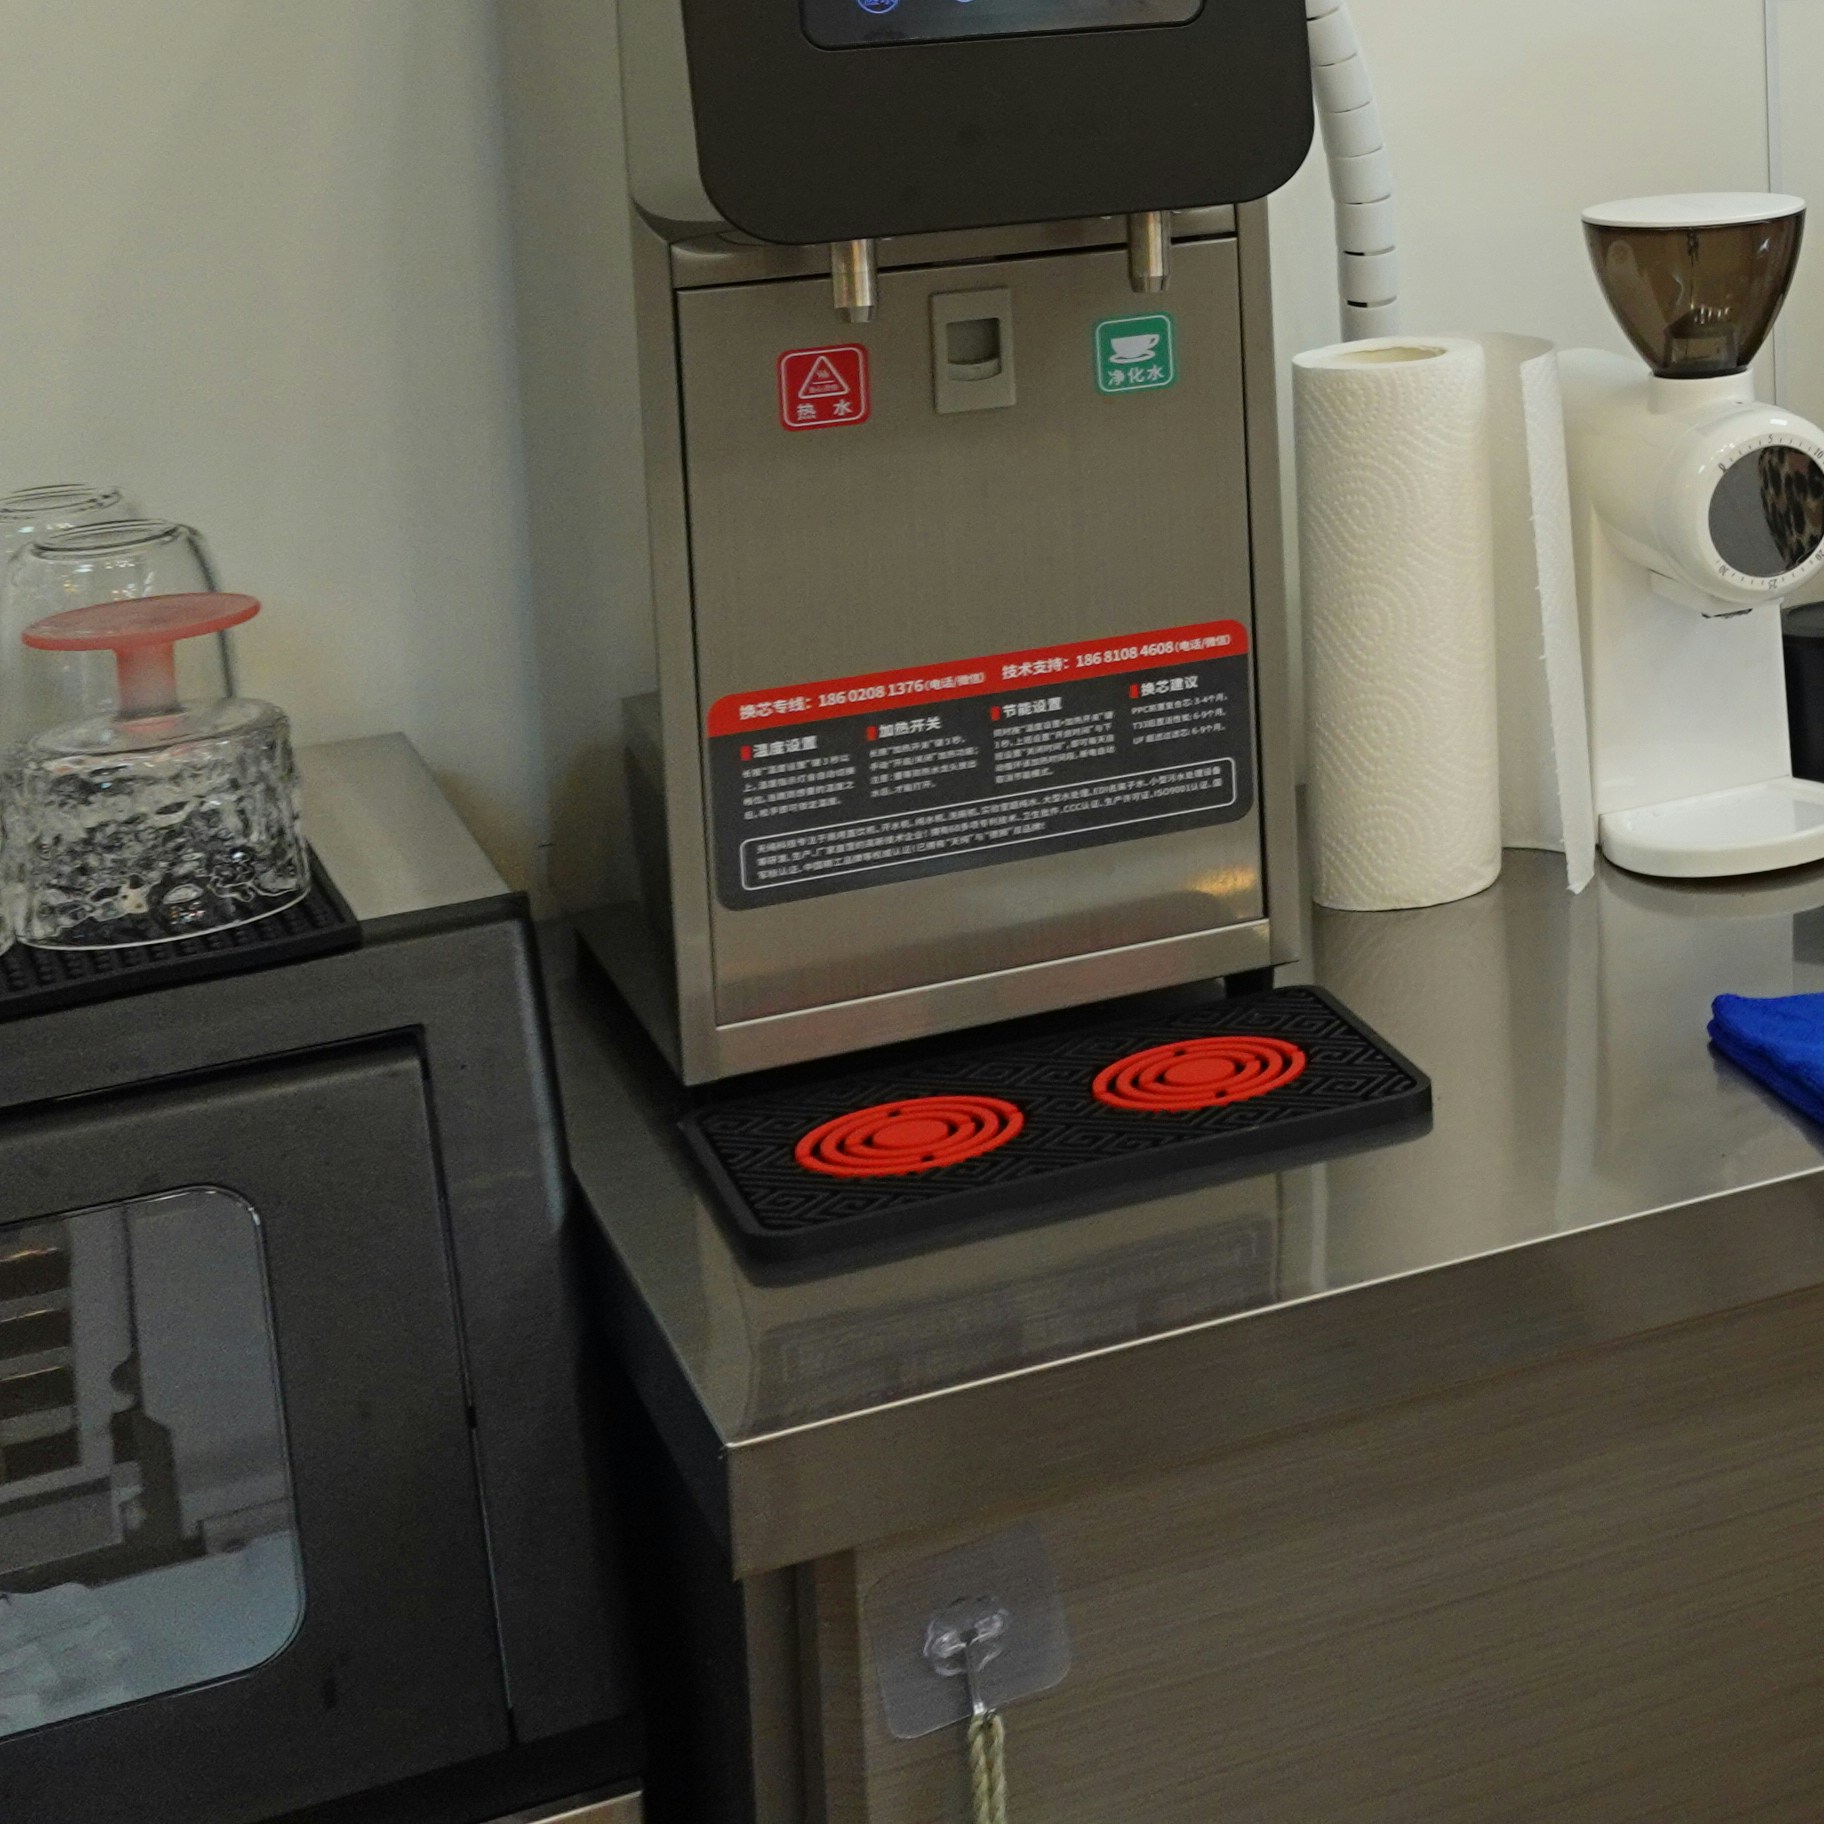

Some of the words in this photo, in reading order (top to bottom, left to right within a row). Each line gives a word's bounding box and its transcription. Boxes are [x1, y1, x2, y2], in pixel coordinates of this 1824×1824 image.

[1108, 366, 1165, 385] 净化水
[1076, 653, 1102, 668] 186
[1103, 648, 1138, 663] 8108
[818, 691, 846, 708] 186
[848, 686, 885, 703] 0208
[879, 716, 942, 738] 加热开关
